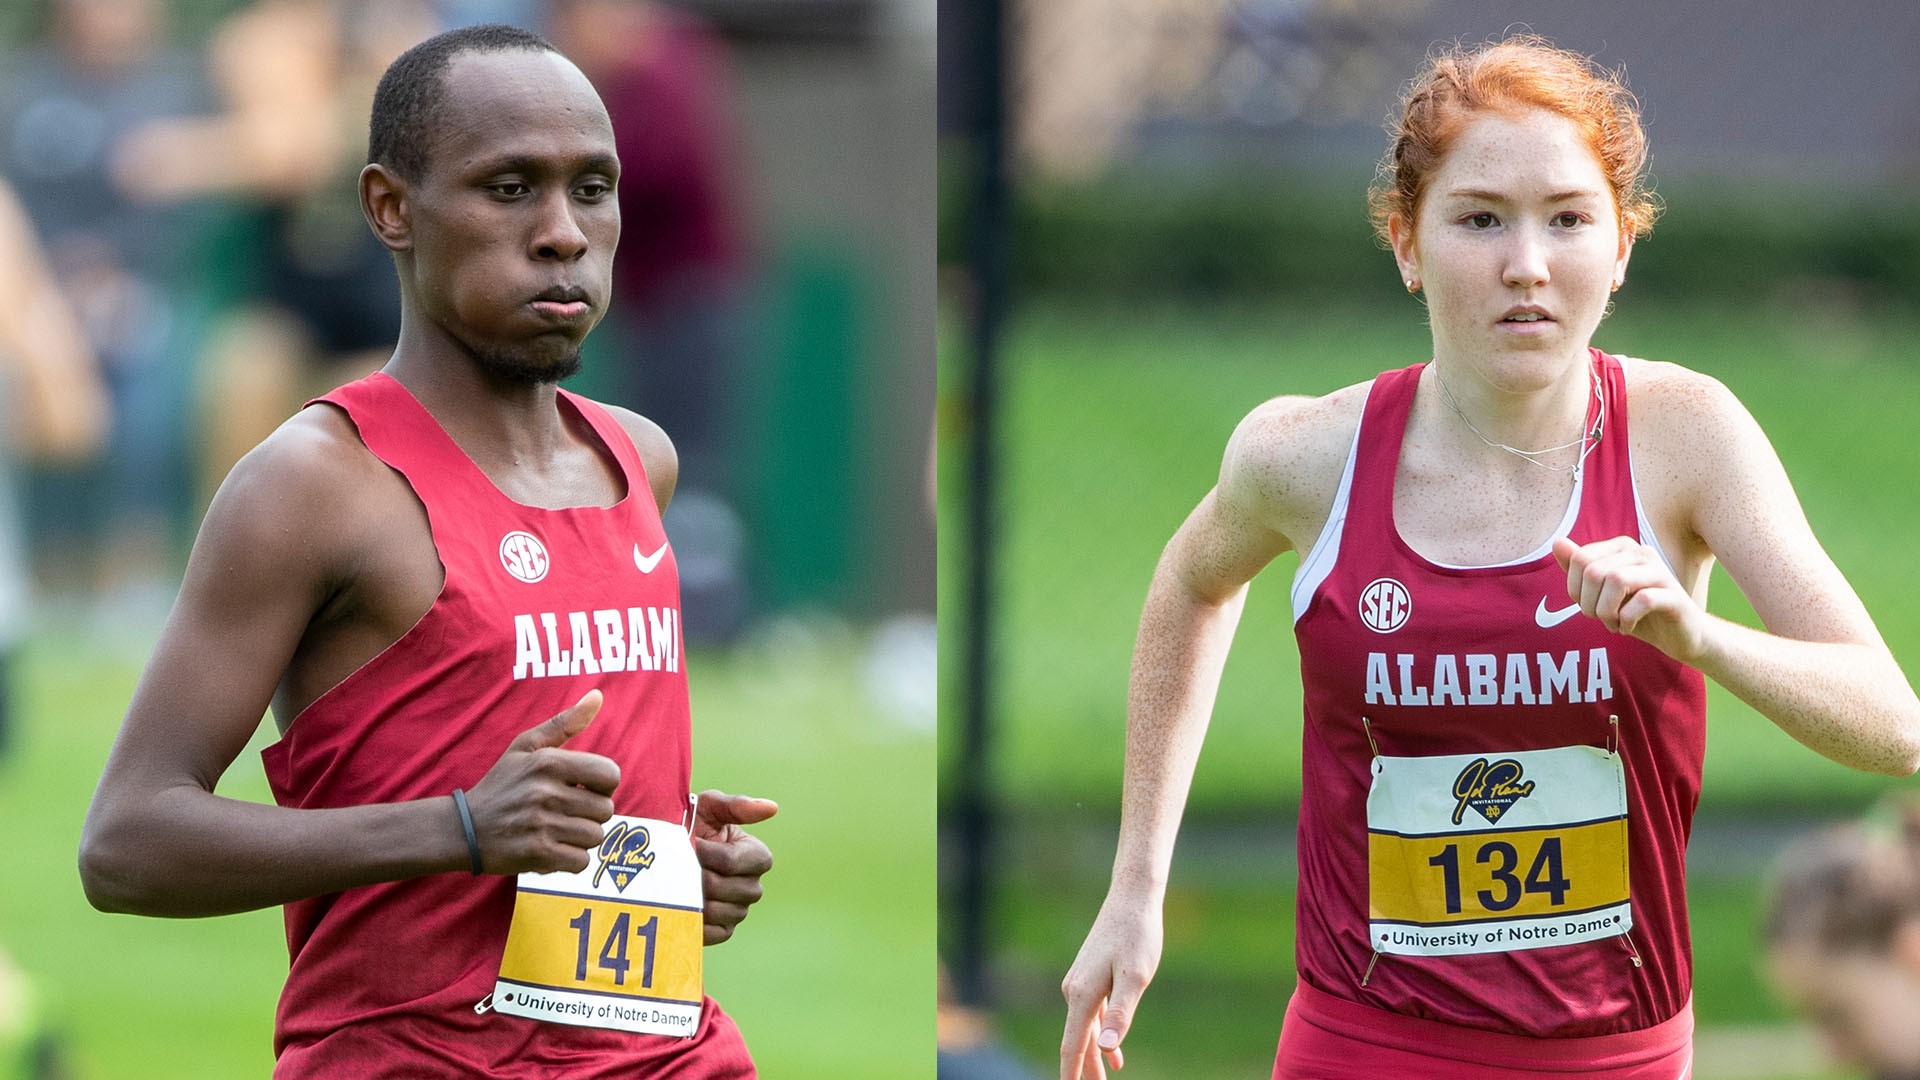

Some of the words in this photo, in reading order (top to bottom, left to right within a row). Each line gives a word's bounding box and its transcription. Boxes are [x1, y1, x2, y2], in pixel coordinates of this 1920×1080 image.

[502, 534, 547, 580] SEC
[1363, 582, 1408, 630] SEC
[1364, 647, 1613, 706] ALABAMA
[1428, 837, 1571, 915] 134
[569, 908, 658, 989] 141
[1392, 931, 1479, 947] University
[1485, 929, 1503, 943] of
[1508, 926, 1559, 941] Notre
[1565, 917, 1612, 936] Dame
[517, 992, 594, 1019] University
[597, 1004, 611, 1018] of
[614, 1005, 648, 1022] Notre
[651, 1010, 687, 1026] Dame
